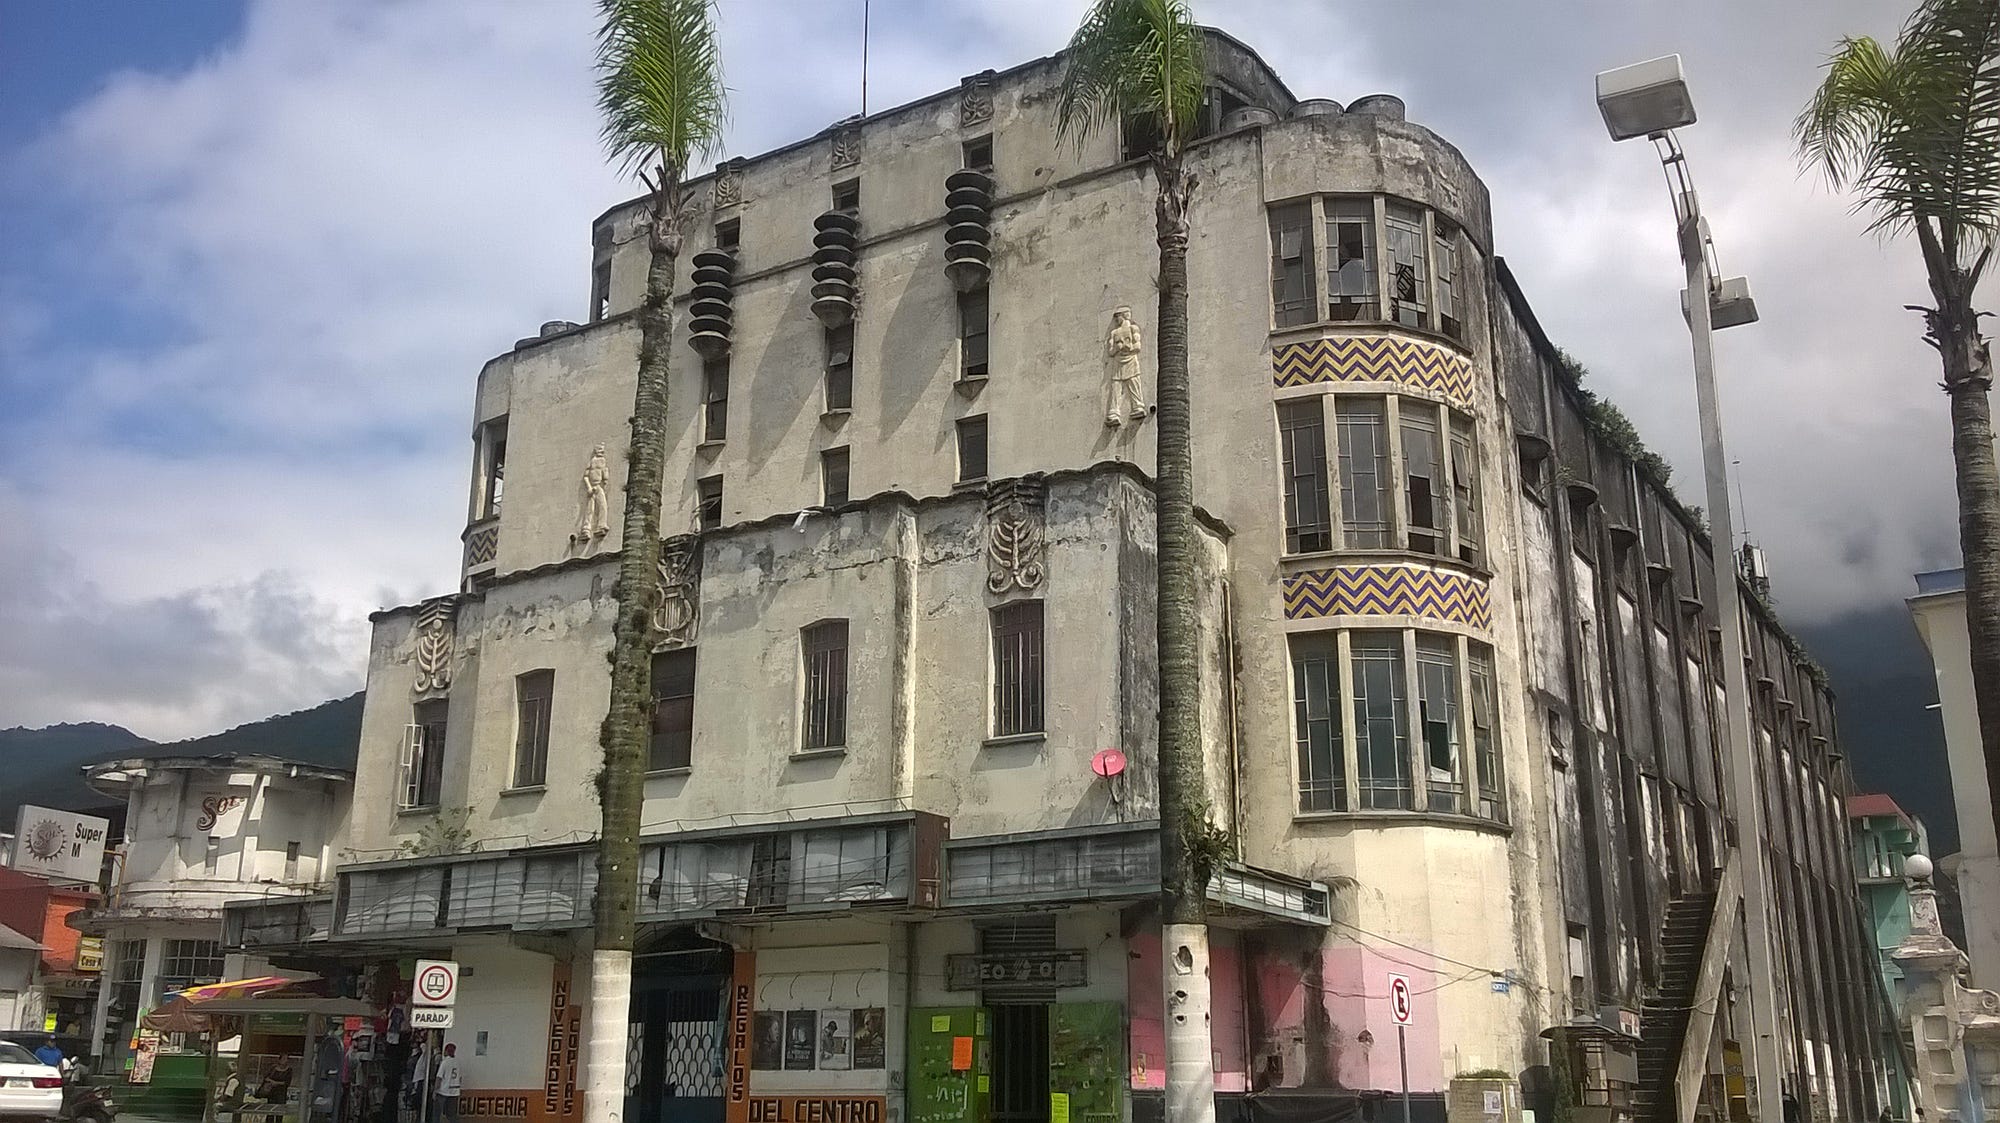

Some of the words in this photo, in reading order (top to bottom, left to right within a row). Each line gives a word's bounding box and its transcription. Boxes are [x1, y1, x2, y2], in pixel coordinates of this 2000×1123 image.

[75, 822, 104, 844] Super
[71, 842, 82, 858] M
[545, 980, 567, 1114] NOVEDADES
[731, 985, 748, 1103] REGALOS
[563, 1019, 580, 1116] COPIAS
[458, 1096, 528, 1117] GUETERIA
[747, 1099, 788, 1123] DEL
[794, 1099, 881, 1123] CENTRO
